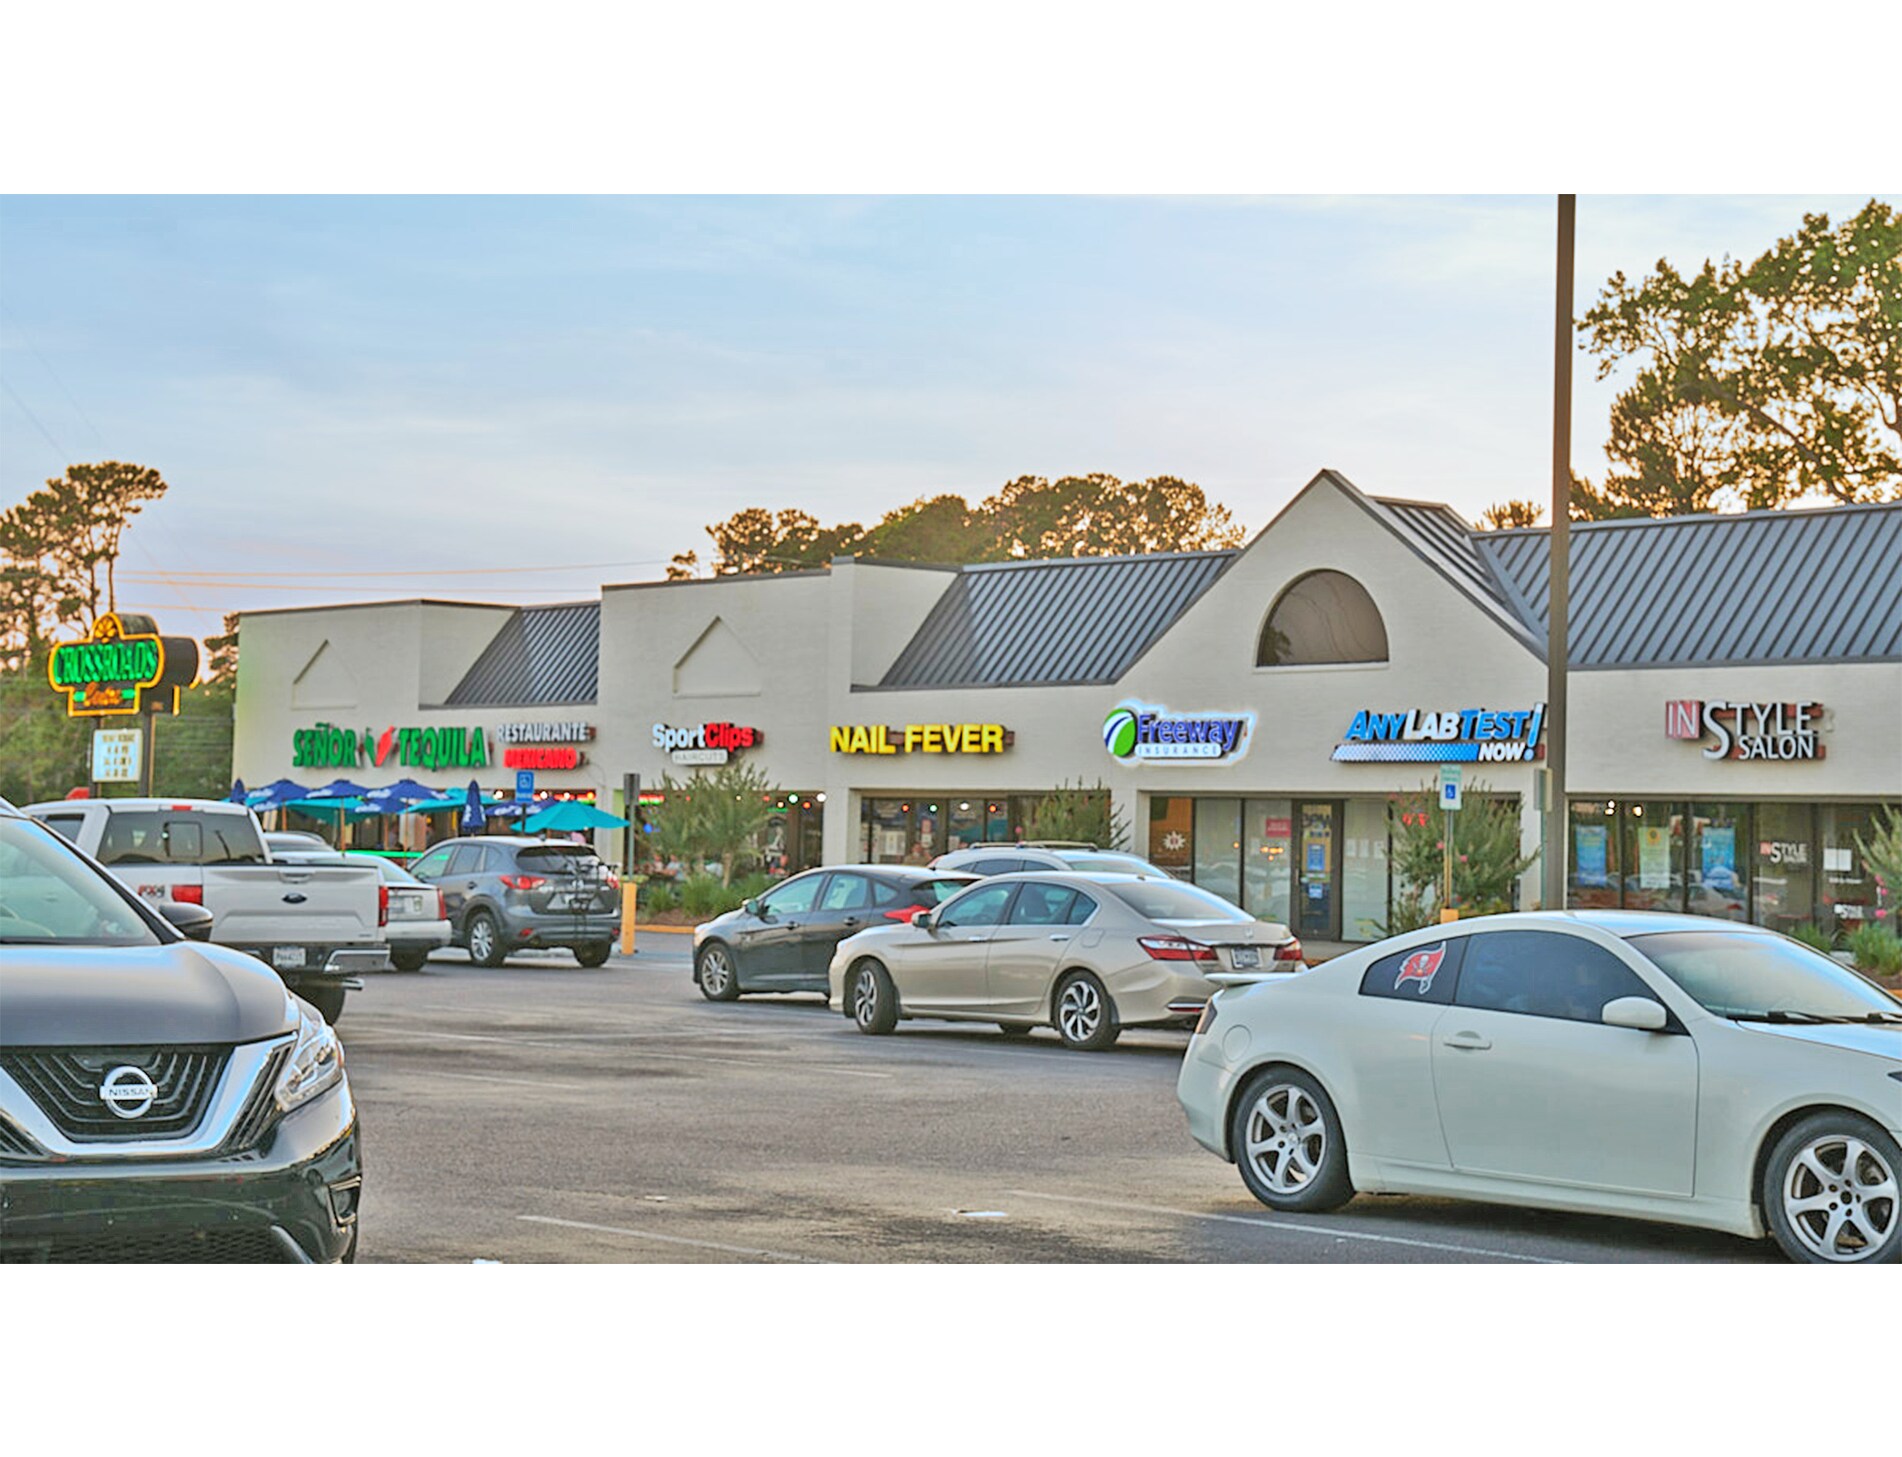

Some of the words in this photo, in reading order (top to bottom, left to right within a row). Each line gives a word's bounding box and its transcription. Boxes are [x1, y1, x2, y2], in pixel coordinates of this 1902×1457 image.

[53, 641, 157, 684] CROSSROADS
[496, 722, 588, 742] RESTAURANTE
[829, 724, 897, 754] NAIL
[903, 723, 1004, 753] FEVER
[1137, 714, 1238, 751] Freeway
[293, 722, 357, 767] SEÑOR
[399, 726, 487, 772] TEQUILA
[674, 751, 726, 762] HAIRCUTS
[1137, 745, 1218, 756] INSURANCE
[1738, 736, 1814, 759] SALON
